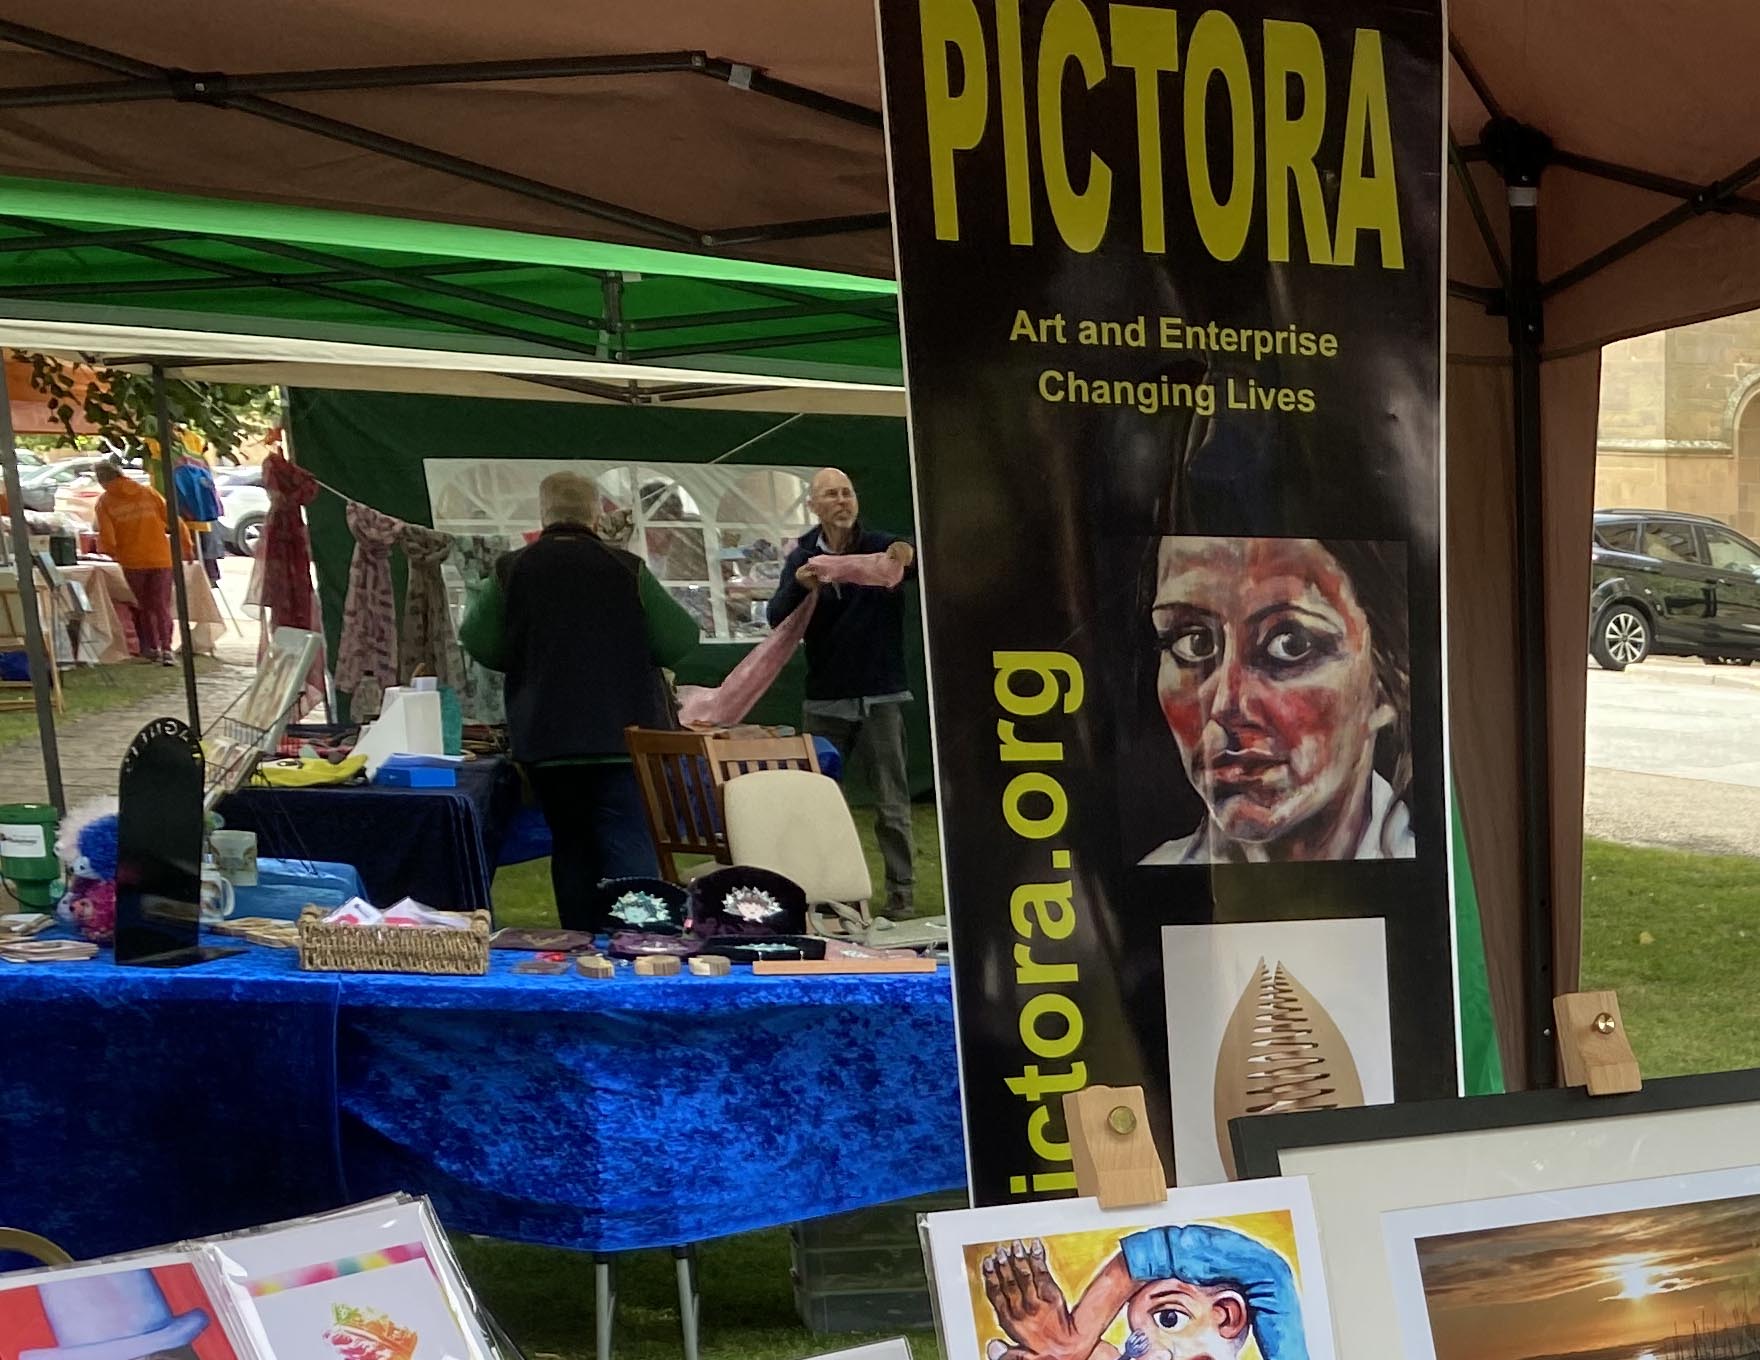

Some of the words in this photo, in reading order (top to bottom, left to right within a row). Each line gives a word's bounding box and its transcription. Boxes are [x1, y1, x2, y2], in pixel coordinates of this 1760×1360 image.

[918, 0, 1405, 269] PICTORA
[1010, 310, 1066, 344] Art
[1078, 316, 1146, 348] and
[1159, 318, 1339, 360] Enterprise
[1038, 370, 1216, 416] Changing
[1227, 378, 1316, 413] Lives
[993, 651, 1087, 1194] ictora.org
